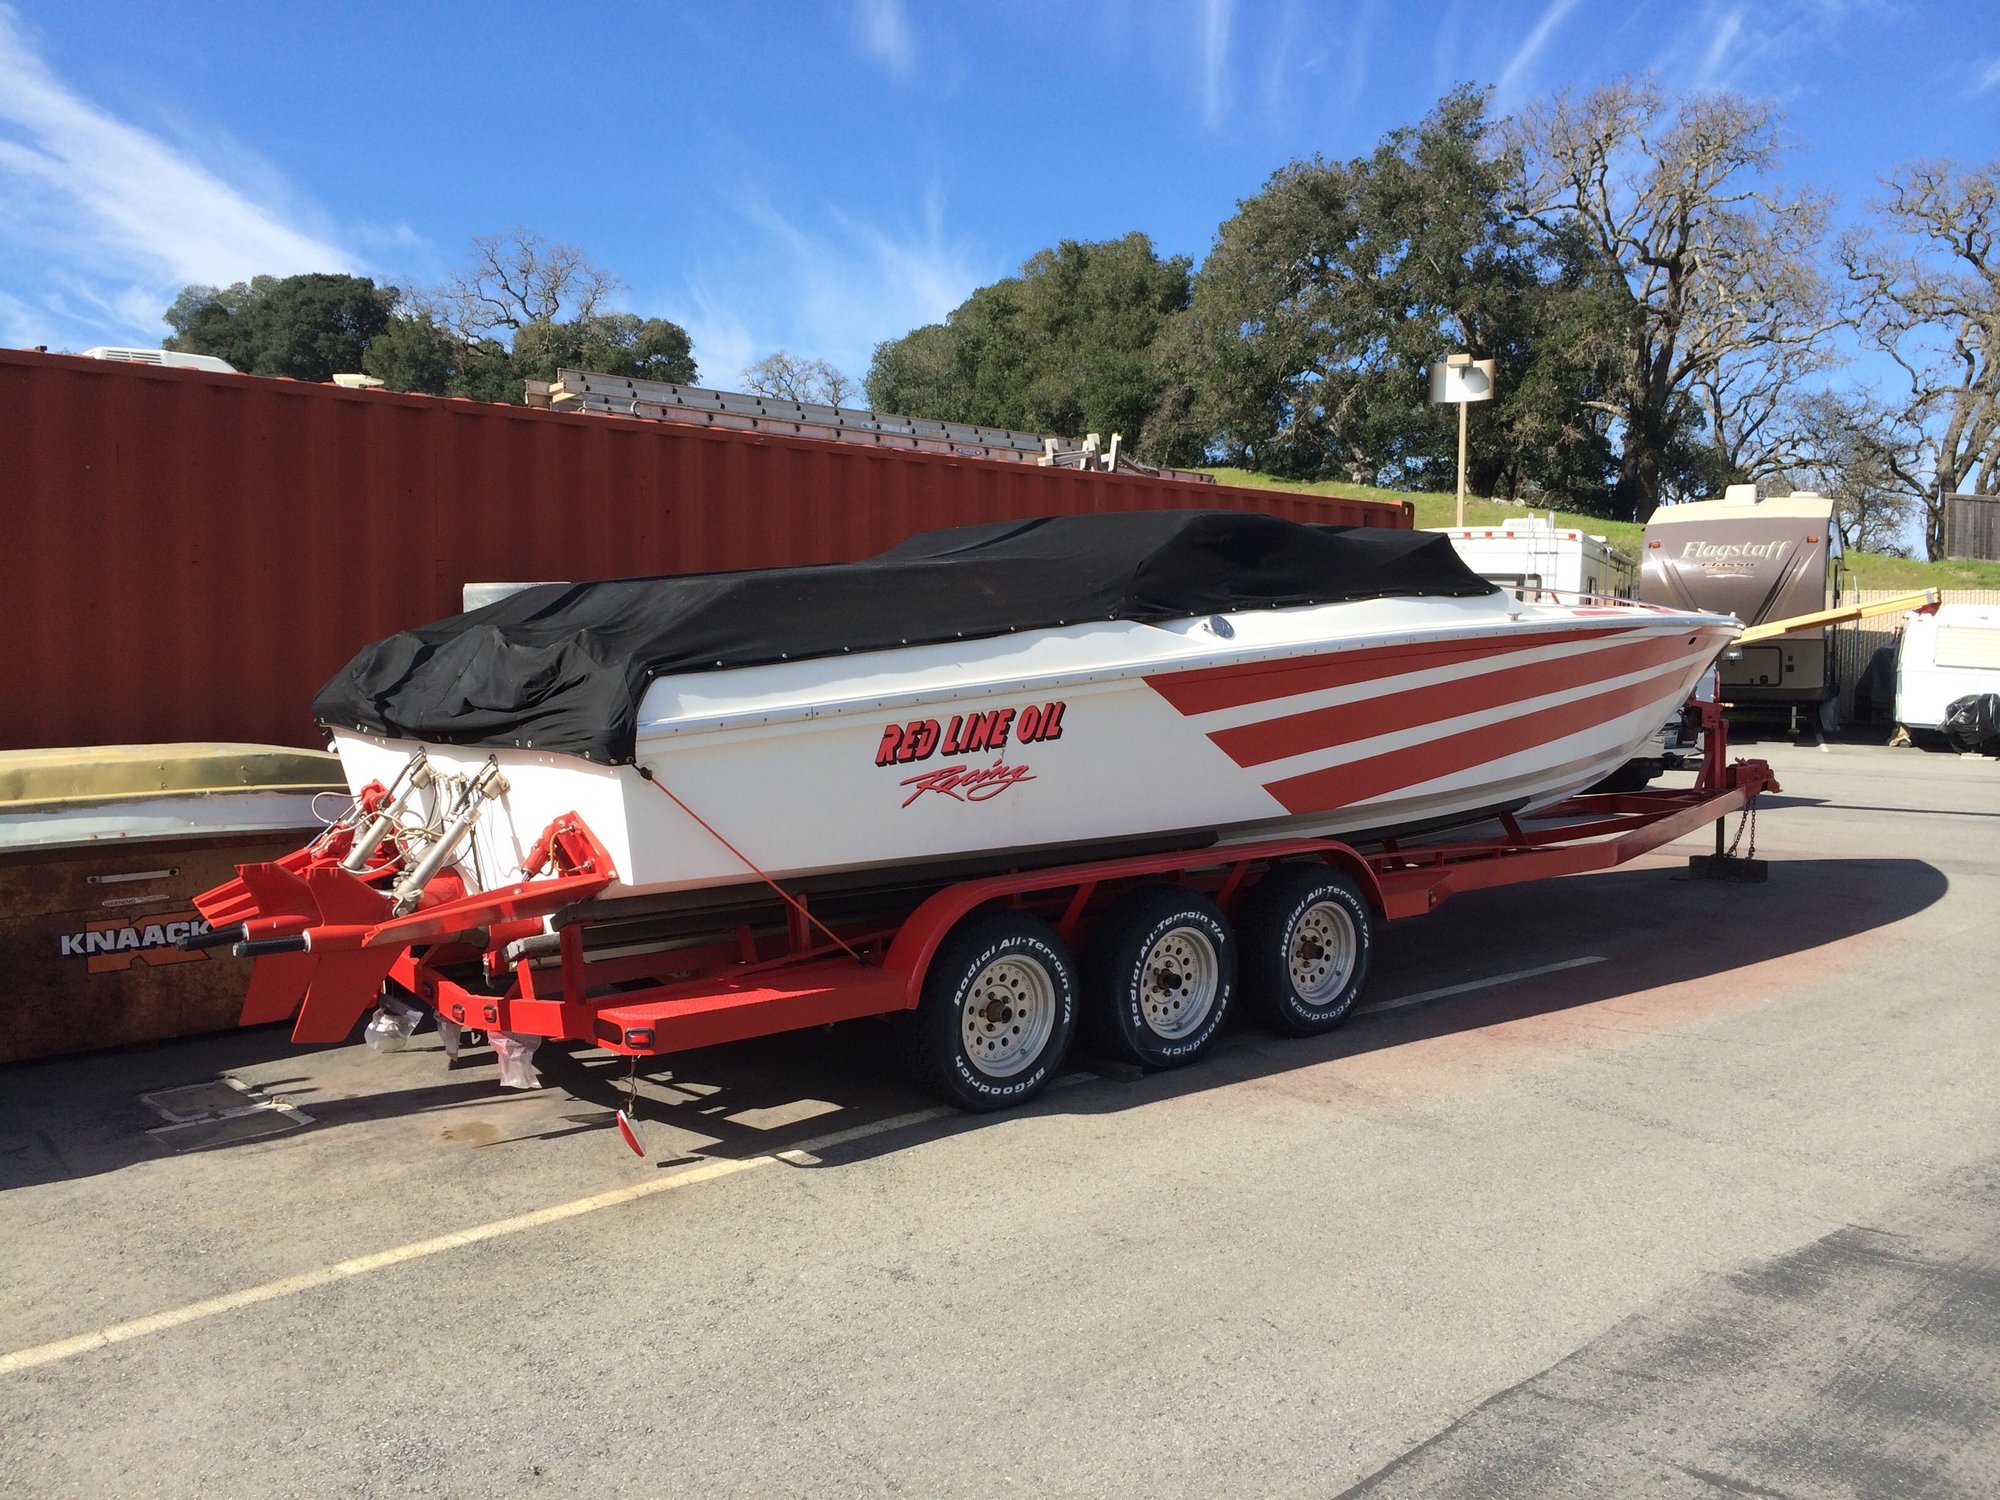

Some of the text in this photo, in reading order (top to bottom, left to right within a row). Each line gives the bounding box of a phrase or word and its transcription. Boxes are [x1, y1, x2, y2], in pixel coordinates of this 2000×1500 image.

[1681, 540, 1791, 561] Flagstaff
[875, 701, 1066, 767] RED LINE OIL
[900, 758, 1037, 809] Racing
[61, 920, 210, 956] KNAACK
[1280, 899, 1305, 958] Radial
[954, 945, 996, 1006] Radial
[1063, 993, 1071, 1024] T/A
[1130, 960, 1142, 1027] Radial
[1211, 920, 1226, 943] T/A
[1162, 984, 1231, 1056] BFGoodrich
[1290, 988, 1357, 1021] BFGoodrich
[955, 1055, 1045, 1095] BFGoodrich
